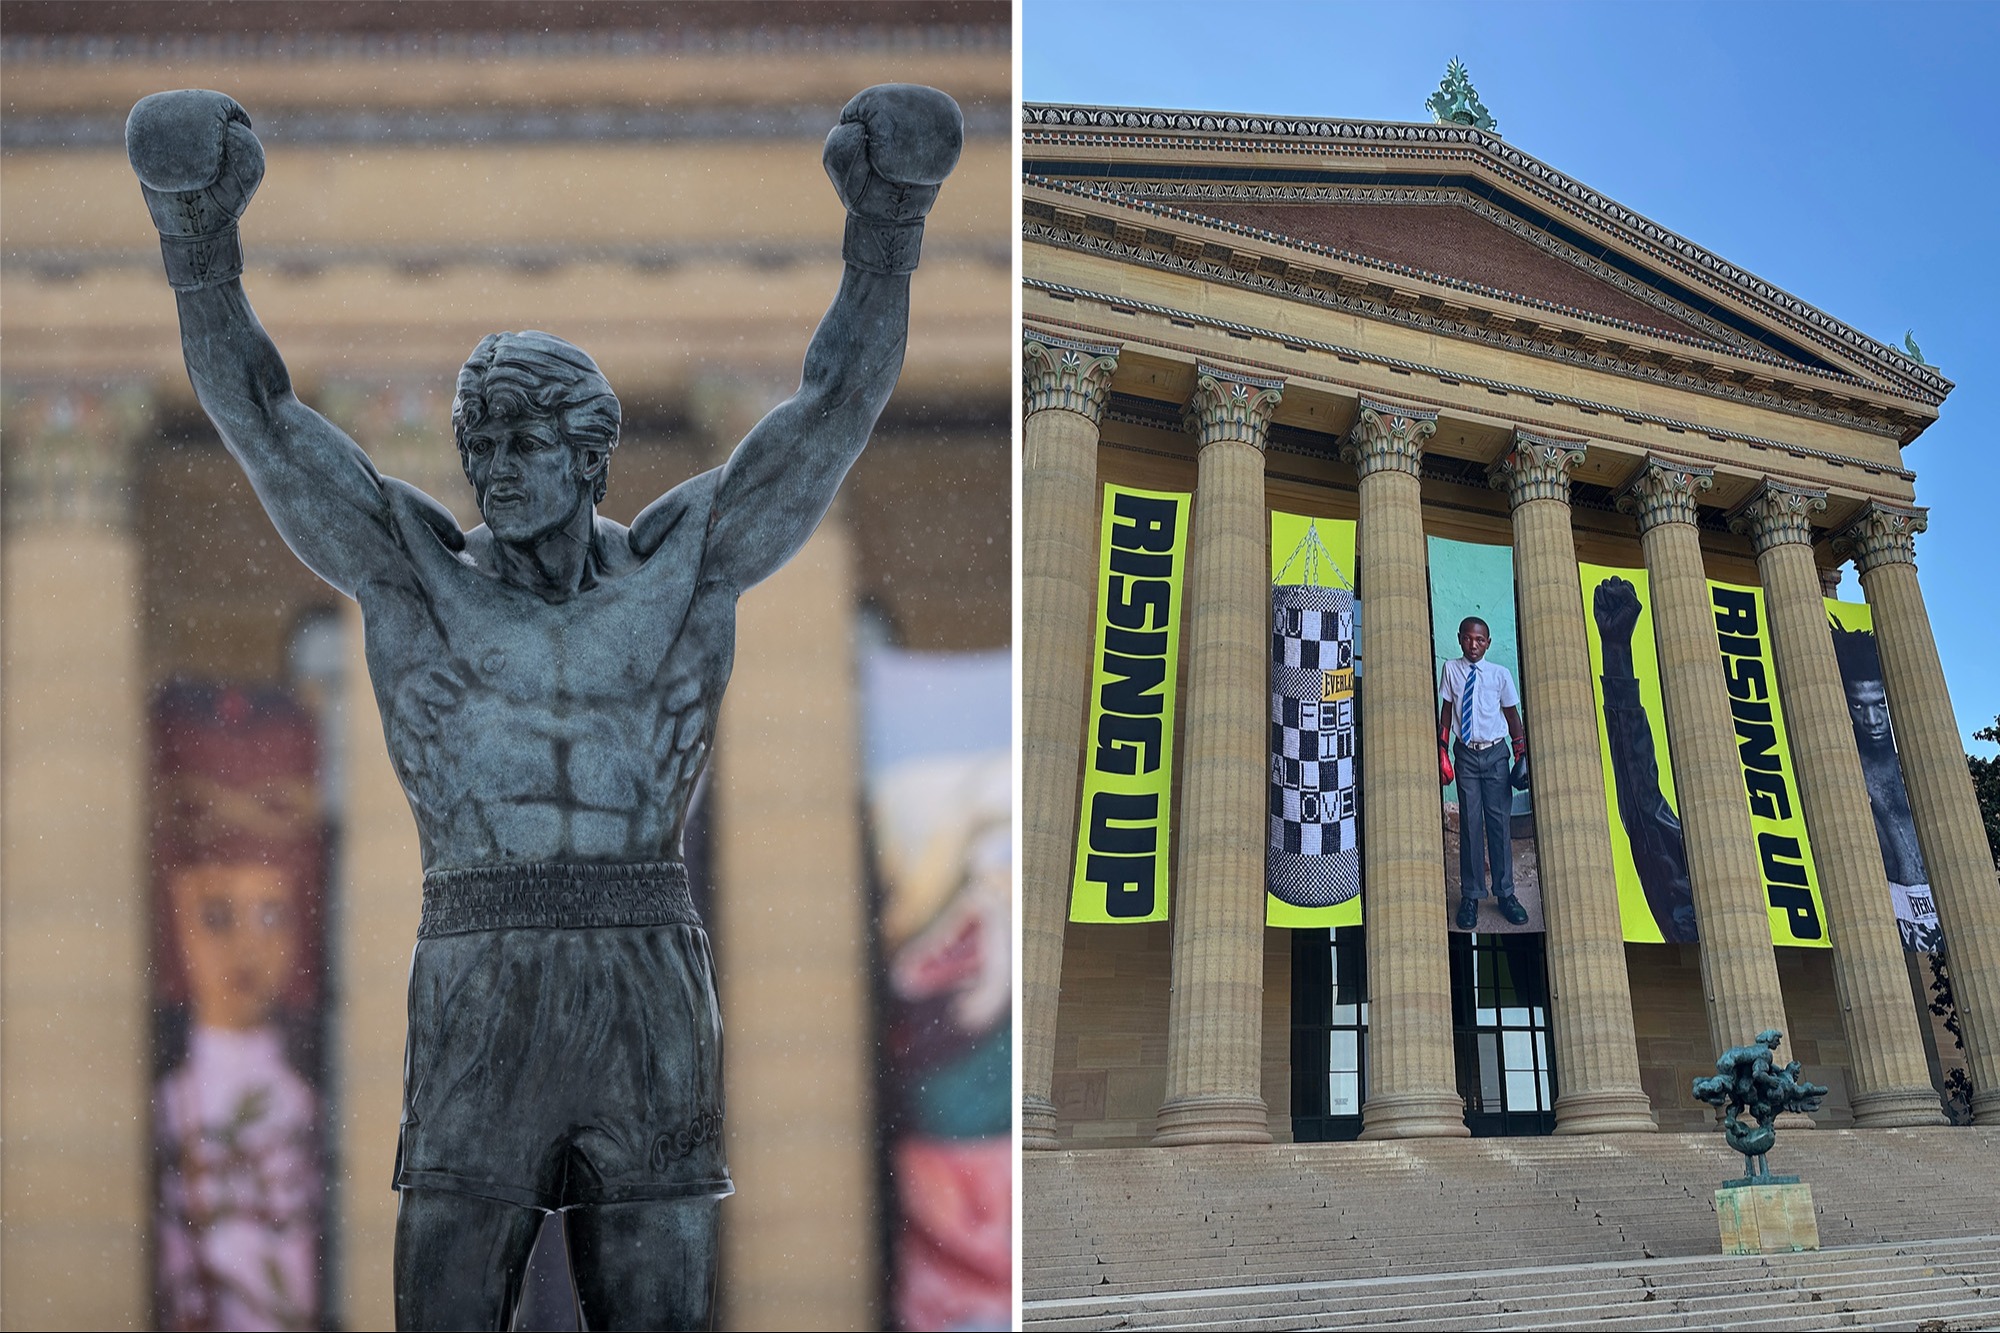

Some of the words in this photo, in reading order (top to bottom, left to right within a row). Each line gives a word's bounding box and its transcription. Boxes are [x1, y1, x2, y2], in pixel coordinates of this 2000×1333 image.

[1096, 492, 1179, 776] RISING
[1324, 672, 1354, 697] EVERLA
[1320, 730, 1350, 759] IT
[1711, 586, 1794, 821] RISING
[1757, 832, 1822, 940] UP
[1086, 792, 1159, 918] UP
